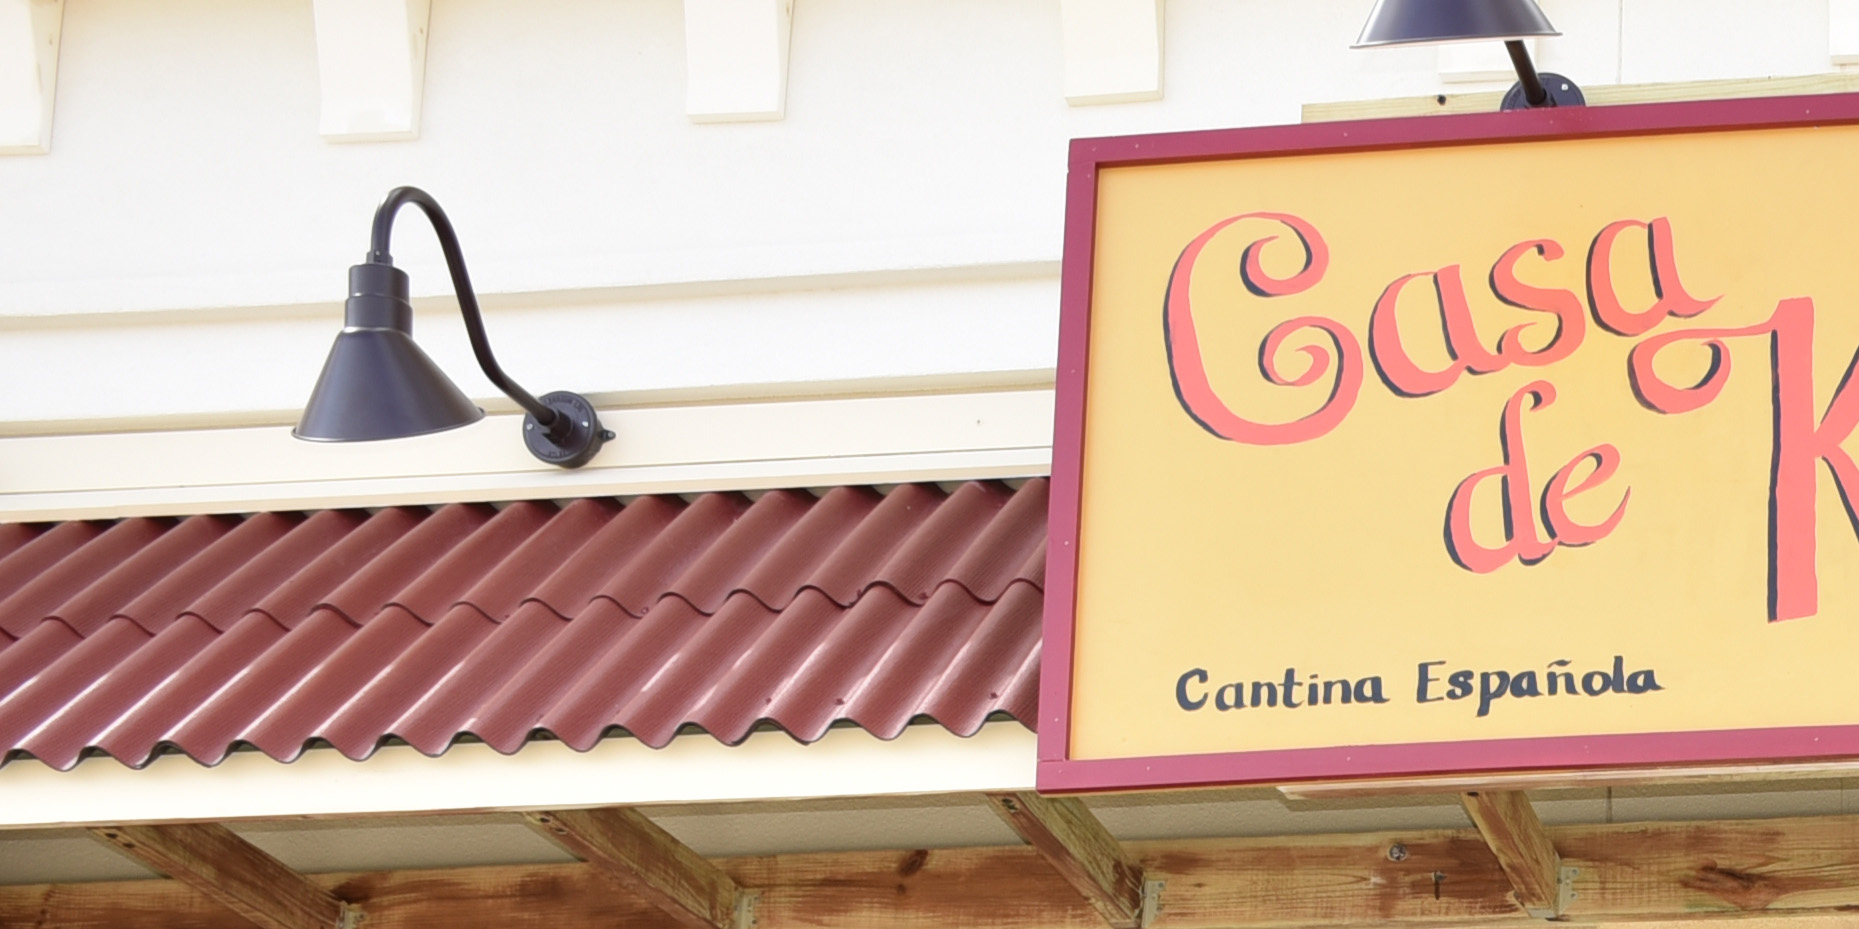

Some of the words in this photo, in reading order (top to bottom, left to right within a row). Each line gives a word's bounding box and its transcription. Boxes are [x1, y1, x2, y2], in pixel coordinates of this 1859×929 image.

[1163, 211, 1726, 446] Casa
[1443, 380, 1631, 574] de
[1176, 668, 1390, 711] Cantina
[1416, 656, 1666, 717] Española
